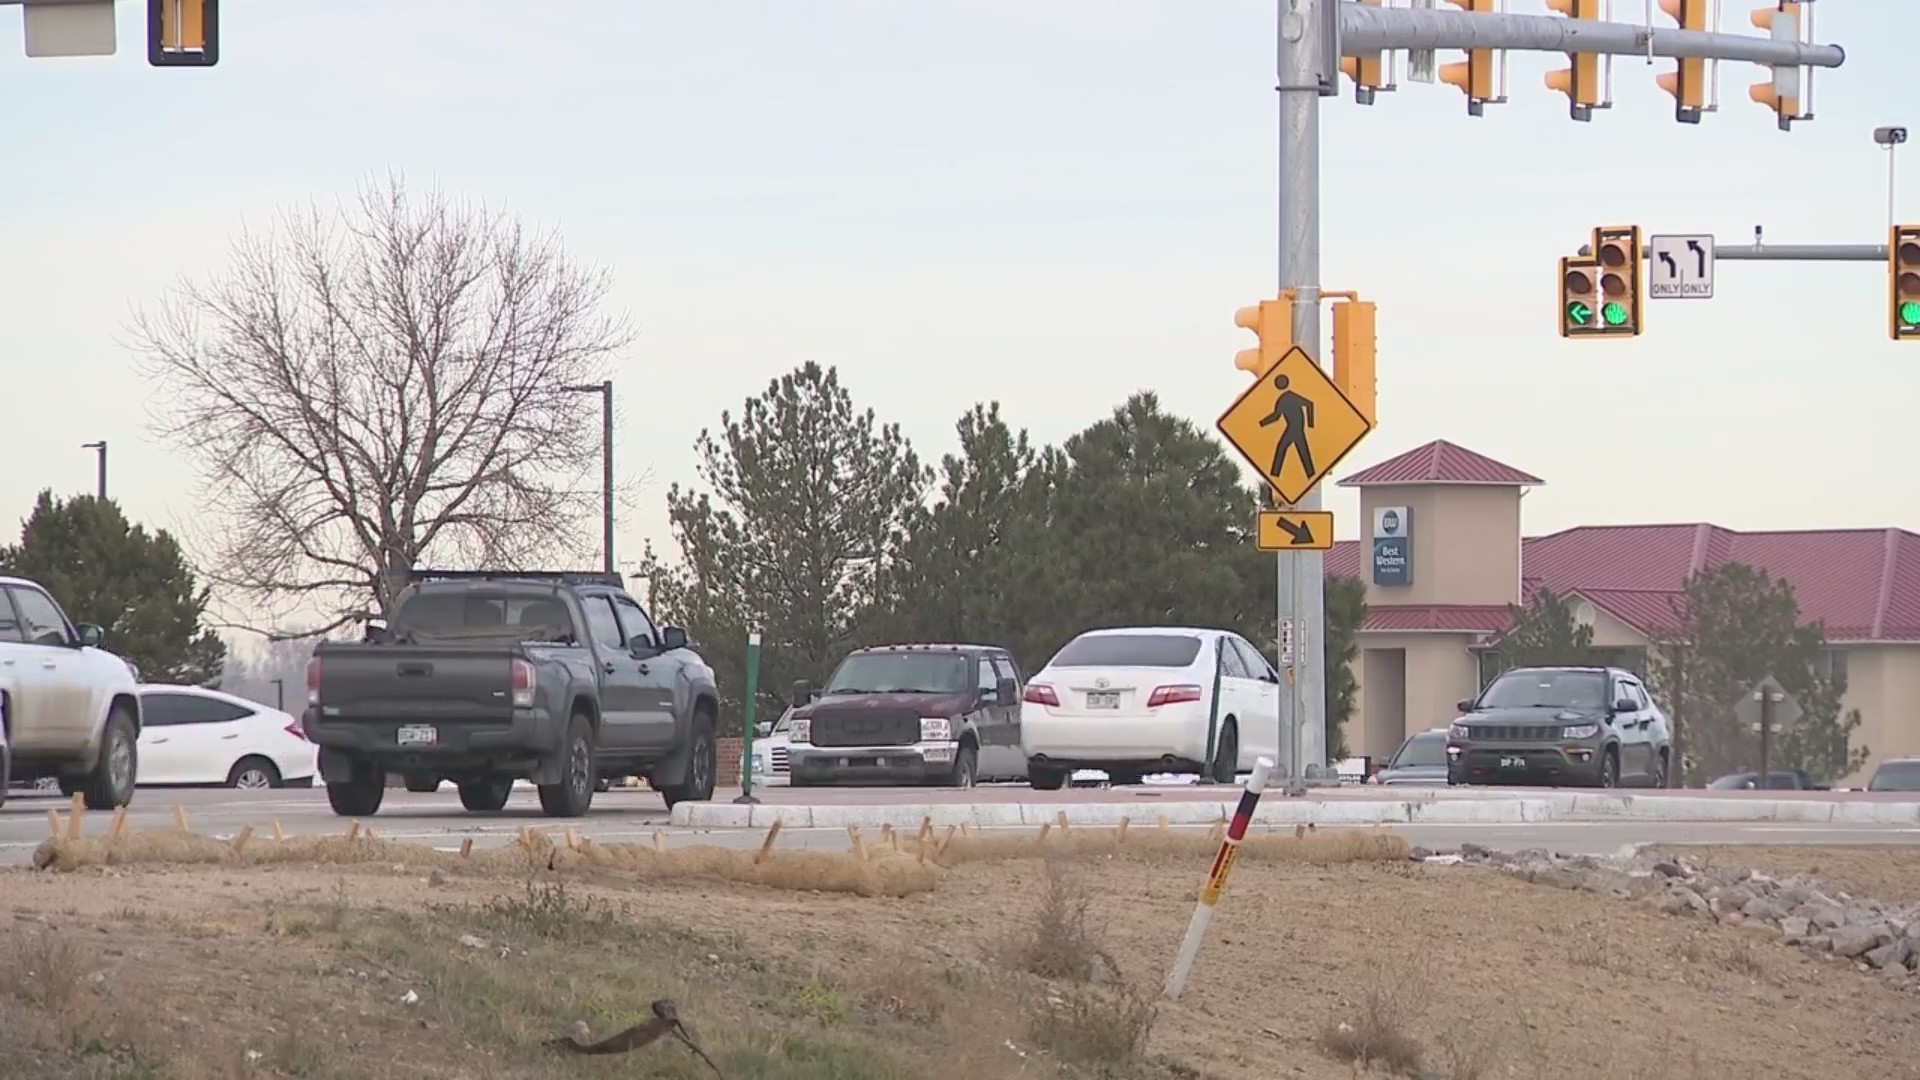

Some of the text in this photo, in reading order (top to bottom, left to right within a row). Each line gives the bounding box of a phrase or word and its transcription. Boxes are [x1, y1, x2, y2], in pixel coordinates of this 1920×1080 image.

[1654, 283, 1710, 294] ONLY ONLY
[1383, 546, 1398, 556] Best
[1376, 556, 1405, 566] Western
